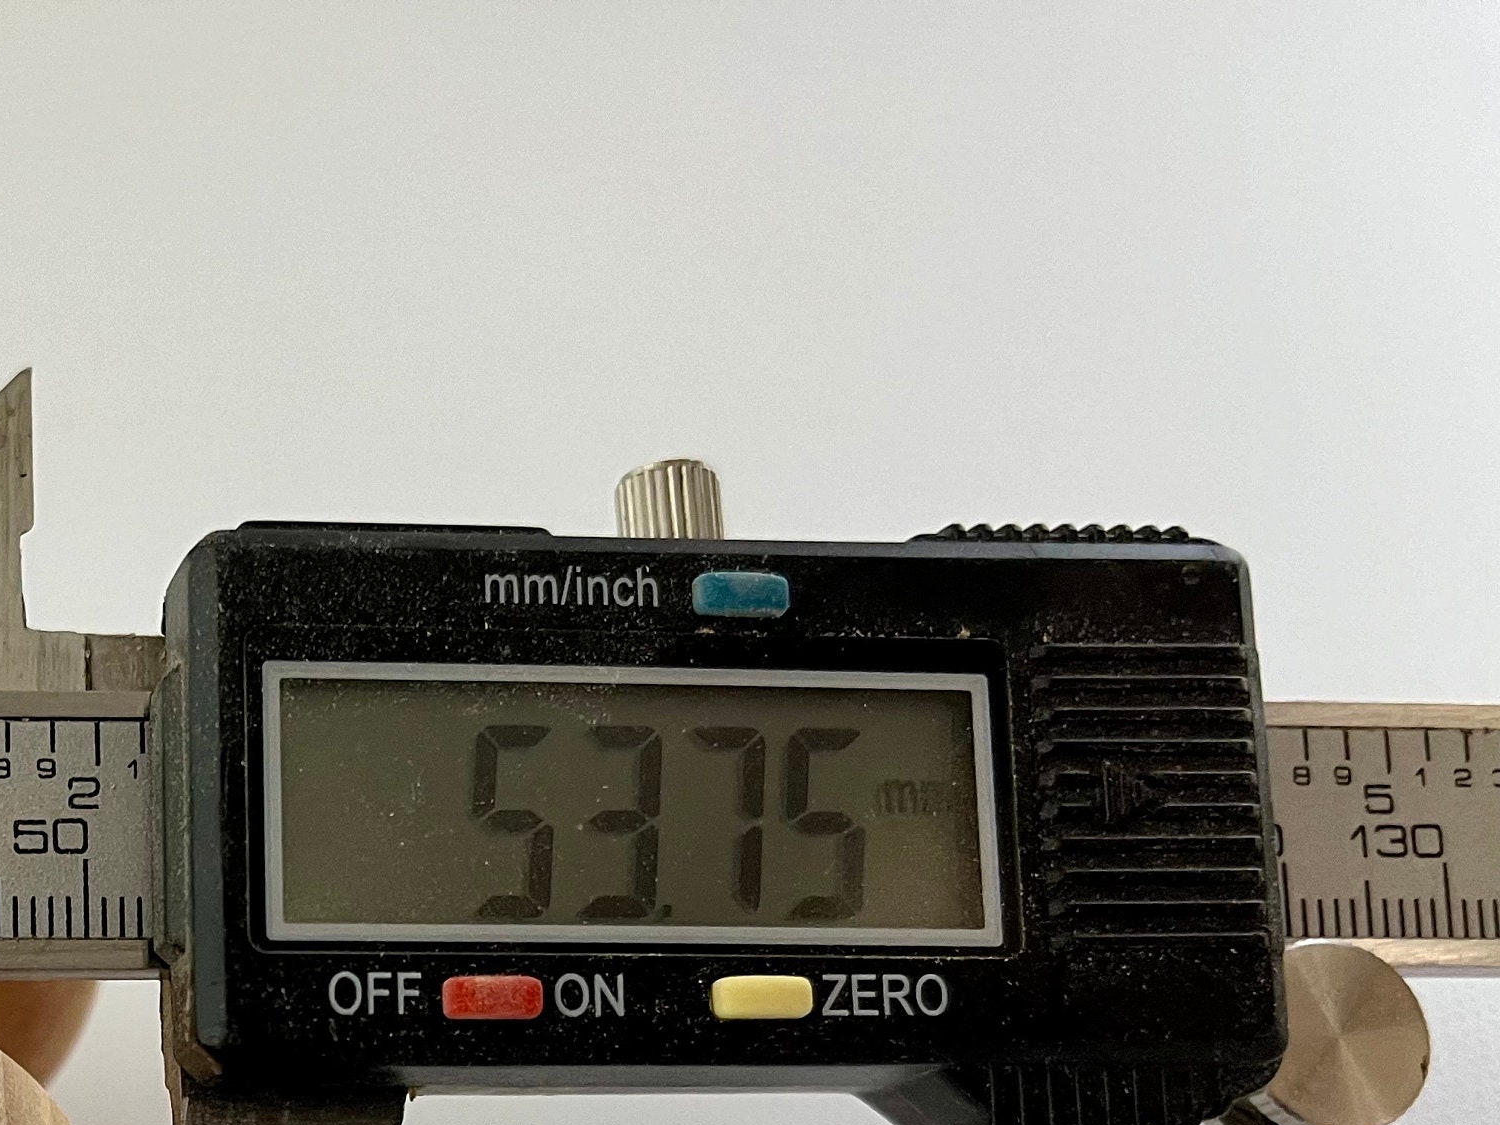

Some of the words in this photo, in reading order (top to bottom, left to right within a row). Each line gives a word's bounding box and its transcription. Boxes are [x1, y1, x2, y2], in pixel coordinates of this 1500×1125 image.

[483, 566, 660, 609] mm/inch
[36, 758, 57, 779] 9
[127, 759, 137, 779] 1
[1293, 766, 1311, 786] 8
[1334, 766, 1351, 785] 9
[1415, 768, 1426, 787] 1
[1454, 768, 1472, 787] 2
[67, 777, 100, 810] 2
[1363, 784, 1395, 814] 5
[12, 818, 89, 854] 50
[1350, 824, 1444, 858] 130
[328, 970, 422, 1017] OFF
[553, 971, 626, 1019] ON
[821, 972, 949, 1017] ZERO
